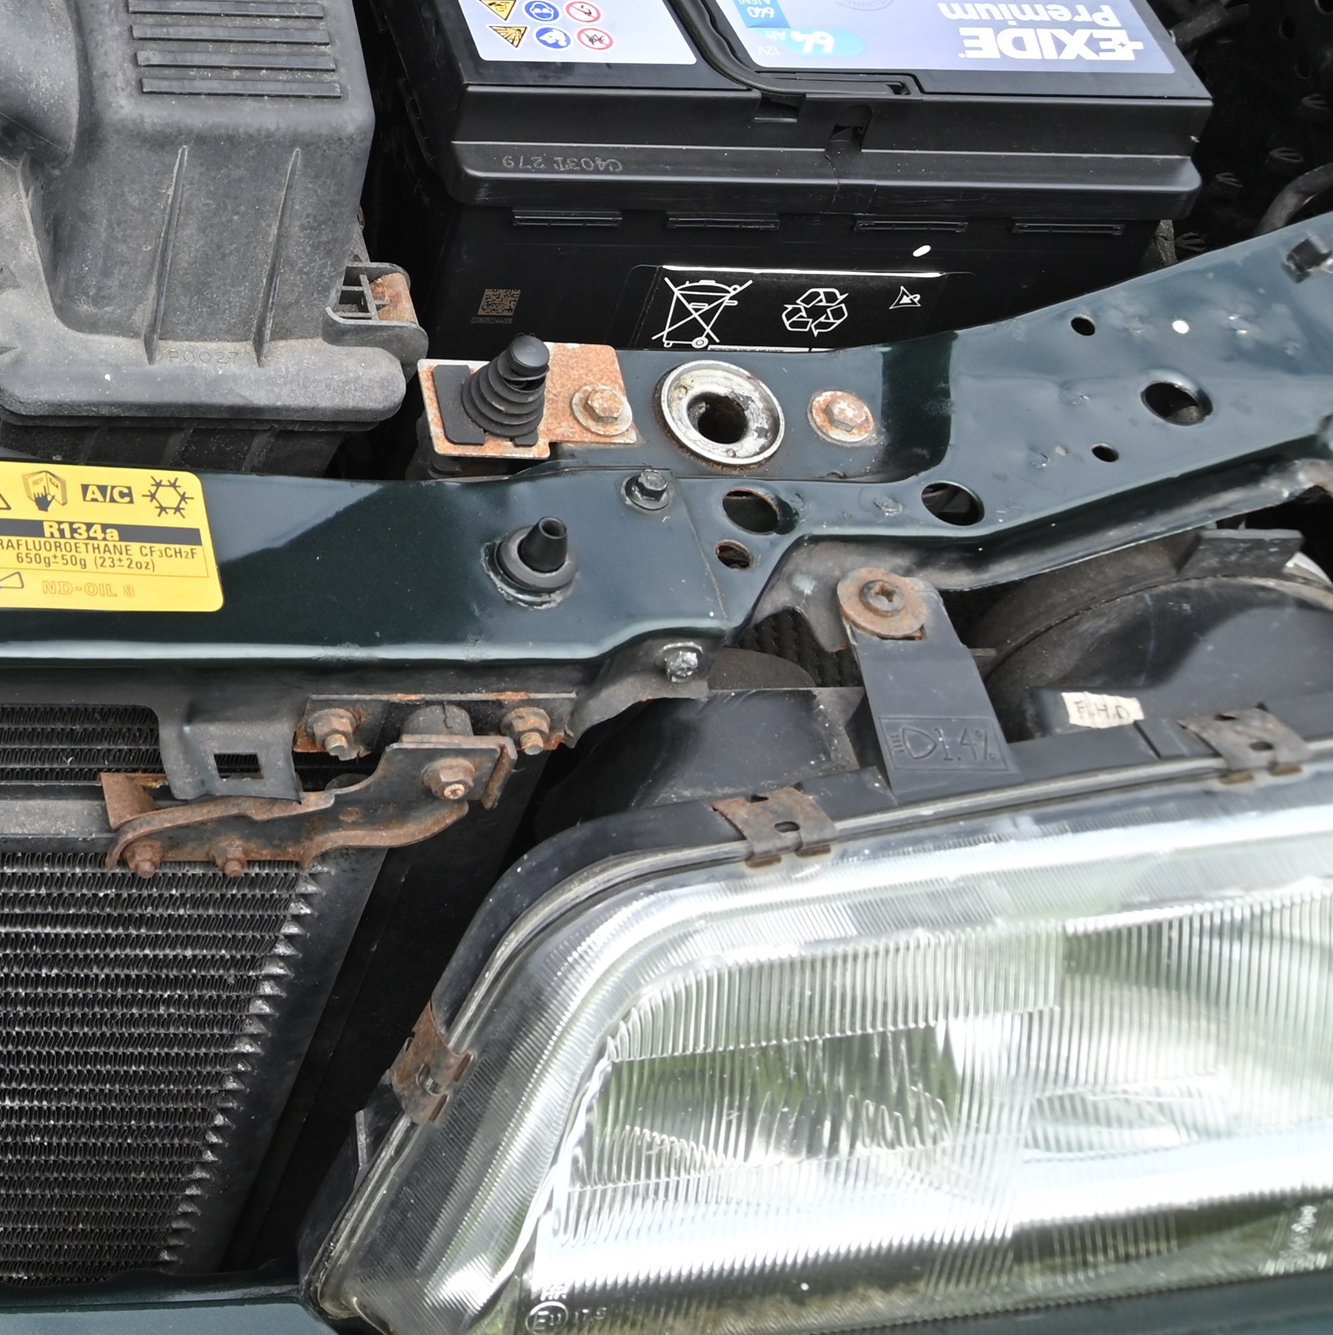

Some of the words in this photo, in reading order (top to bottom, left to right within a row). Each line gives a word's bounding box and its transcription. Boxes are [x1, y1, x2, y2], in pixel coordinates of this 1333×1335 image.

[748, 7, 775, 18] 640
[938, 3, 1122, 27] Premium
[765, 31, 785, 40] Ah
[791, 31, 834, 53] 64
[959, 27, 1139, 60] EXIDE
[758, 46, 780, 55] 12V
[84, 485, 132, 503] A/C
[43, 521, 119, 541] R134a
[43, 580, 117, 597] ND-OIL
[124, 585, 135, 597] 8
